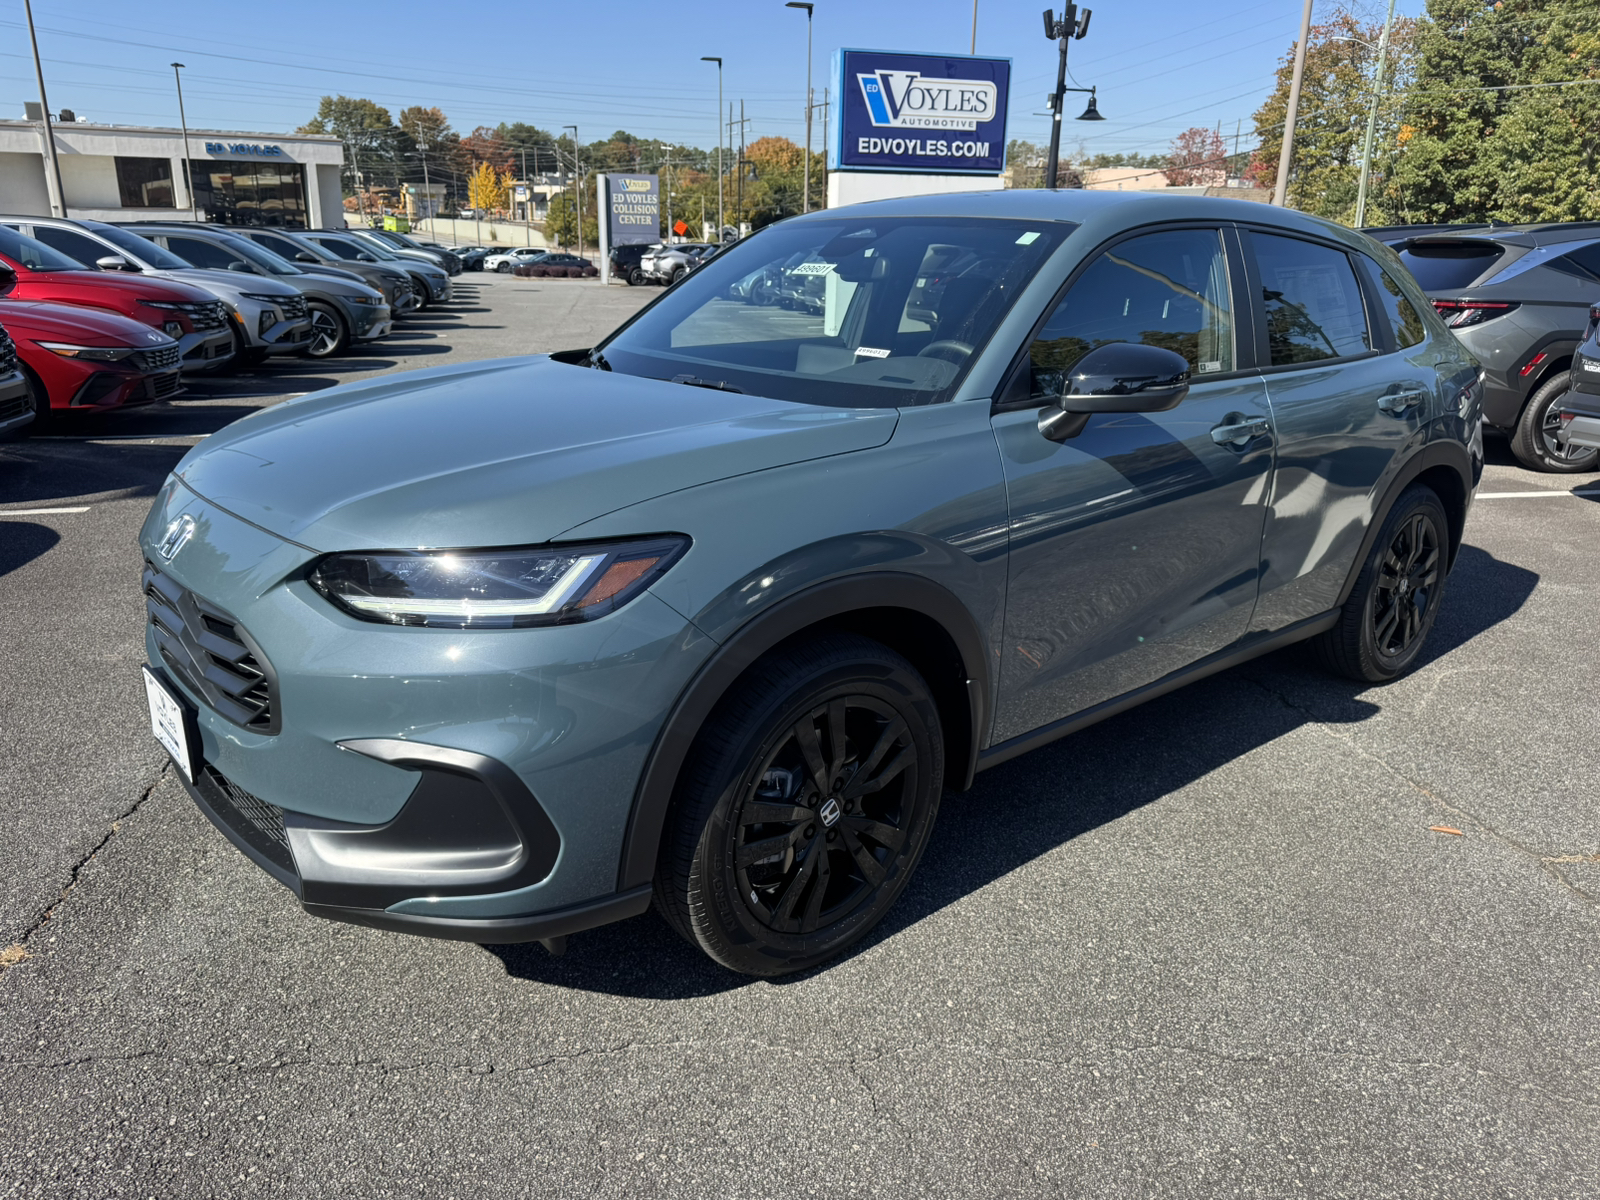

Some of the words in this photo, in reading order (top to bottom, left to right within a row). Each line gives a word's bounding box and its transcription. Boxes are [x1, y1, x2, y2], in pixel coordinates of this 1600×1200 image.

[866, 84, 878, 93] ED
[879, 73, 988, 120] VOYLES
[901, 118, 974, 128] AUTOMOTIVE
[205, 142, 225, 154] ED
[227, 143, 282, 157] VOYLES
[858, 137, 990, 157] EDVOYLES.COM
[612, 193, 625, 203] ED
[626, 193, 658, 204] VOYLES
[613, 204, 658, 214] COLLISION
[619, 215, 652, 225] CENTER
